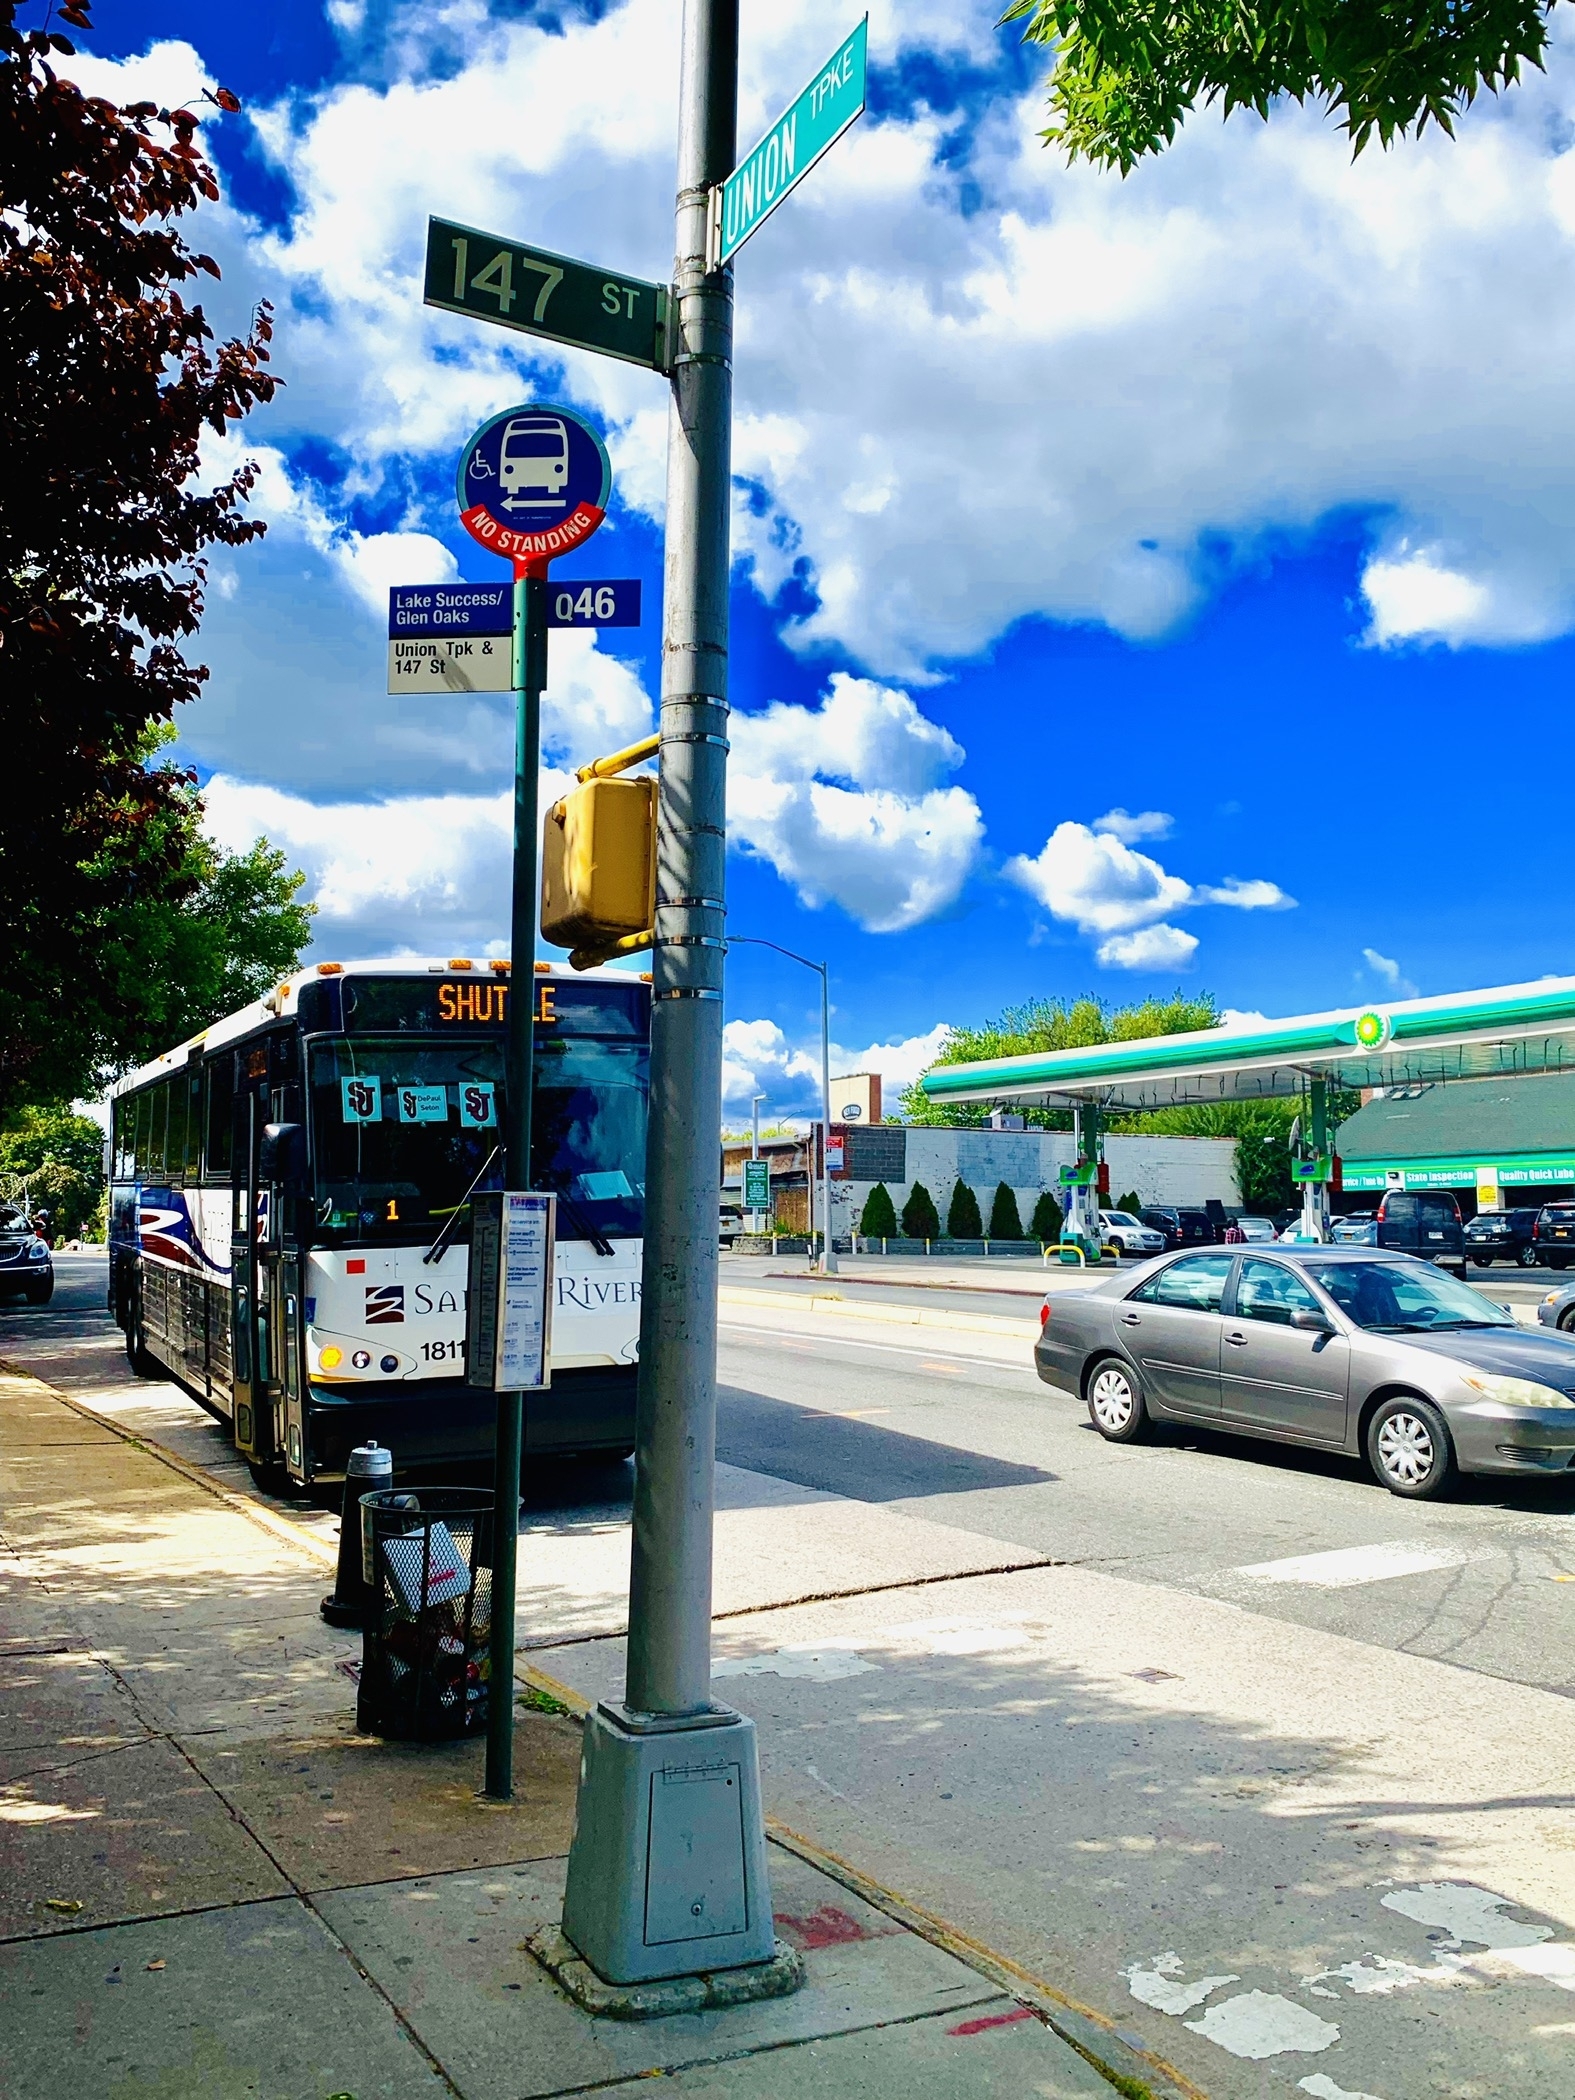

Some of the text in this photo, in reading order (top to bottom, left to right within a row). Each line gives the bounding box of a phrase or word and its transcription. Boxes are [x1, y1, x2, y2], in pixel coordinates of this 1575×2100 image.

[726, 42, 855, 245] UNION TPKE
[451, 237, 640, 323] 147 ST
[471, 511, 592, 552] NO STANDING
[396, 590, 503, 608] Lake Success/
[555, 586, 616, 621] Q46
[396, 609, 470, 625] Glen Oaks
[395, 640, 493, 658] Union Tpk &
[395, 659, 446, 674] 147 St
[439, 984, 556, 1022] SHUTE
[1429, 1170, 1474, 1182] Inspection
[387, 1199, 399, 1220] 1
